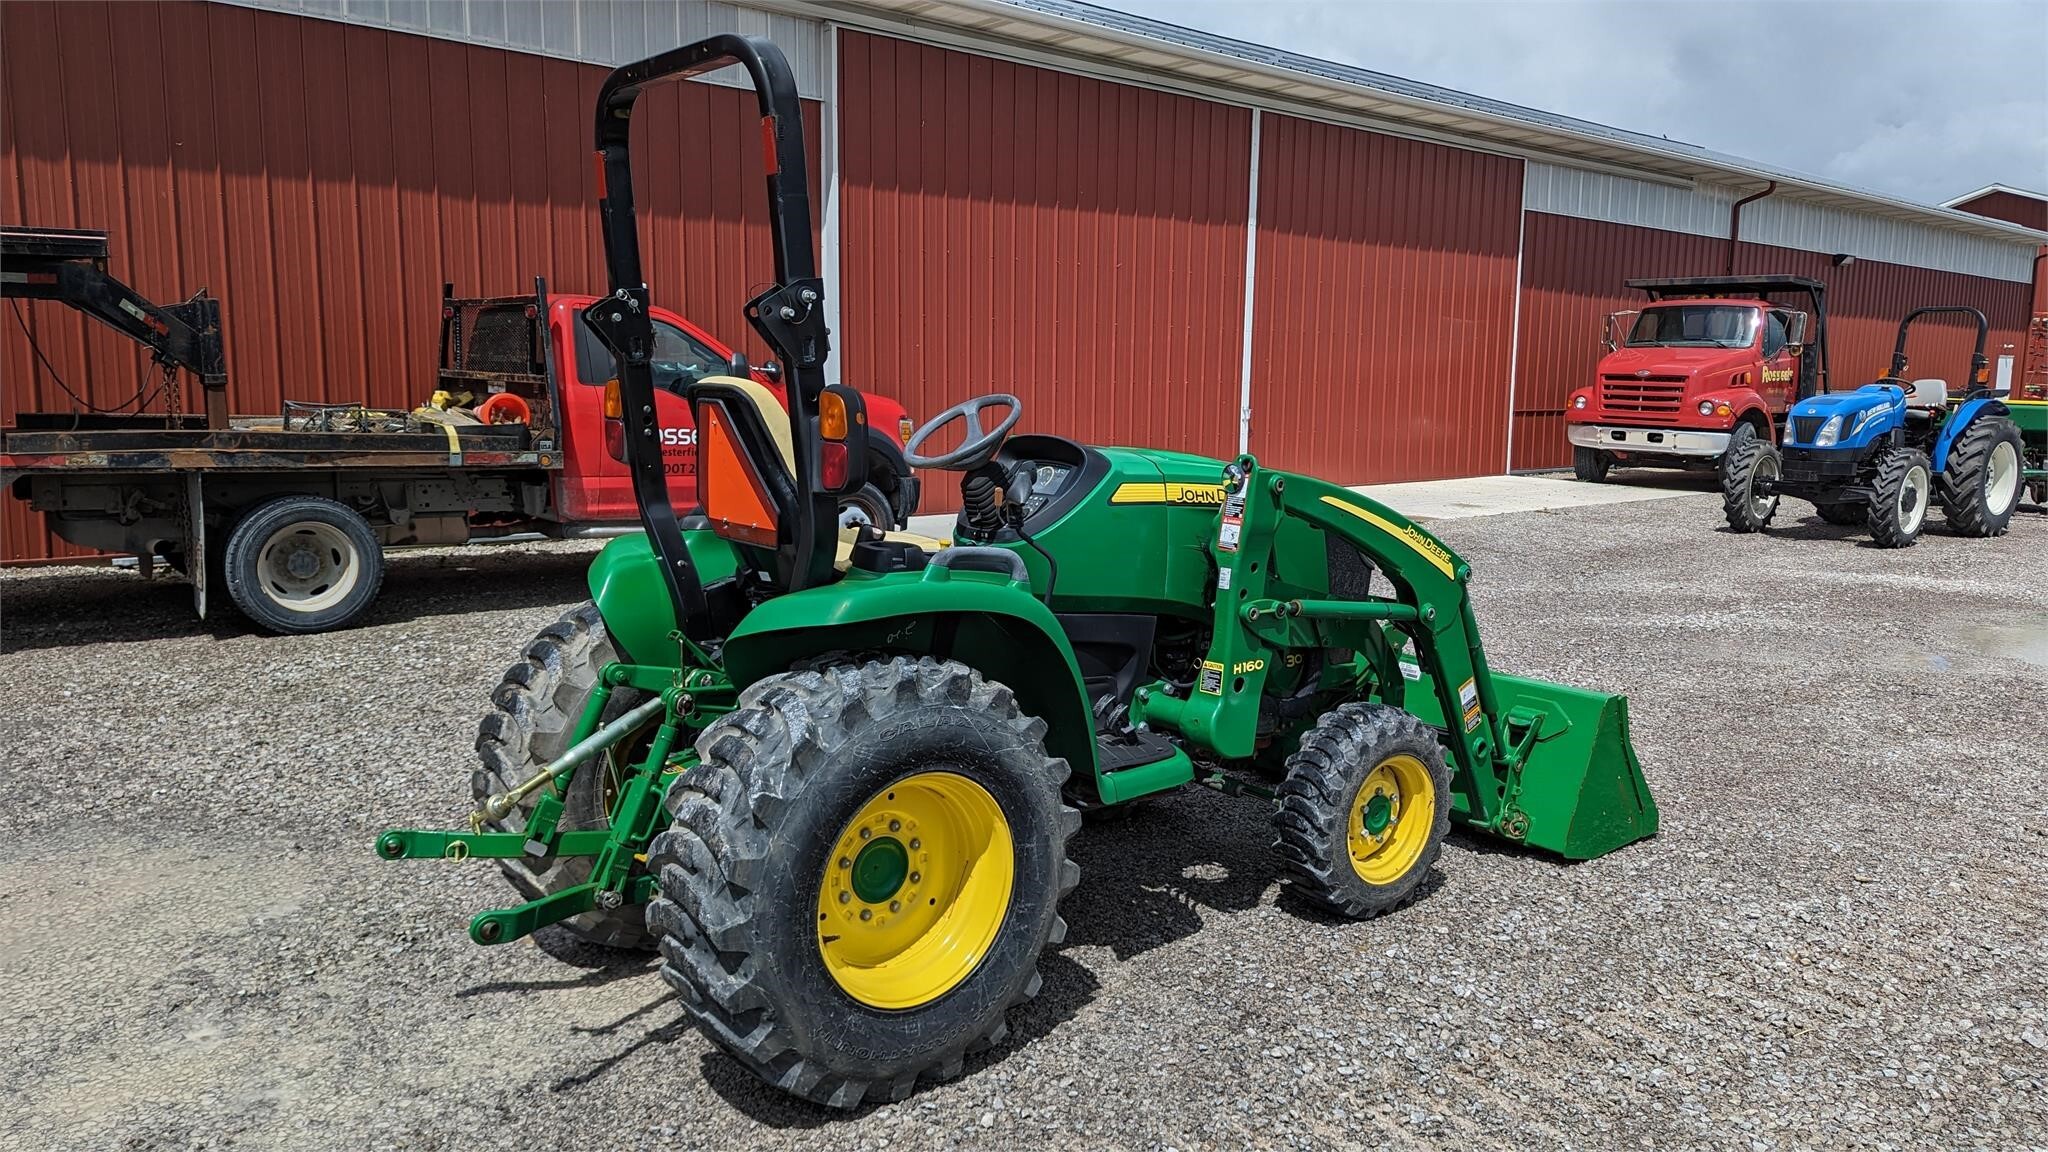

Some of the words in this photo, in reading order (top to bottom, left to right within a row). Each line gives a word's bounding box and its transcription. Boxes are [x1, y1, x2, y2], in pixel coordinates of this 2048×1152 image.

[1176, 487, 1215, 502] JOHN
[1403, 524, 1427, 547] JOHN
[1425, 537, 1452, 564] DEERE
[1233, 659, 1265, 675] H160
